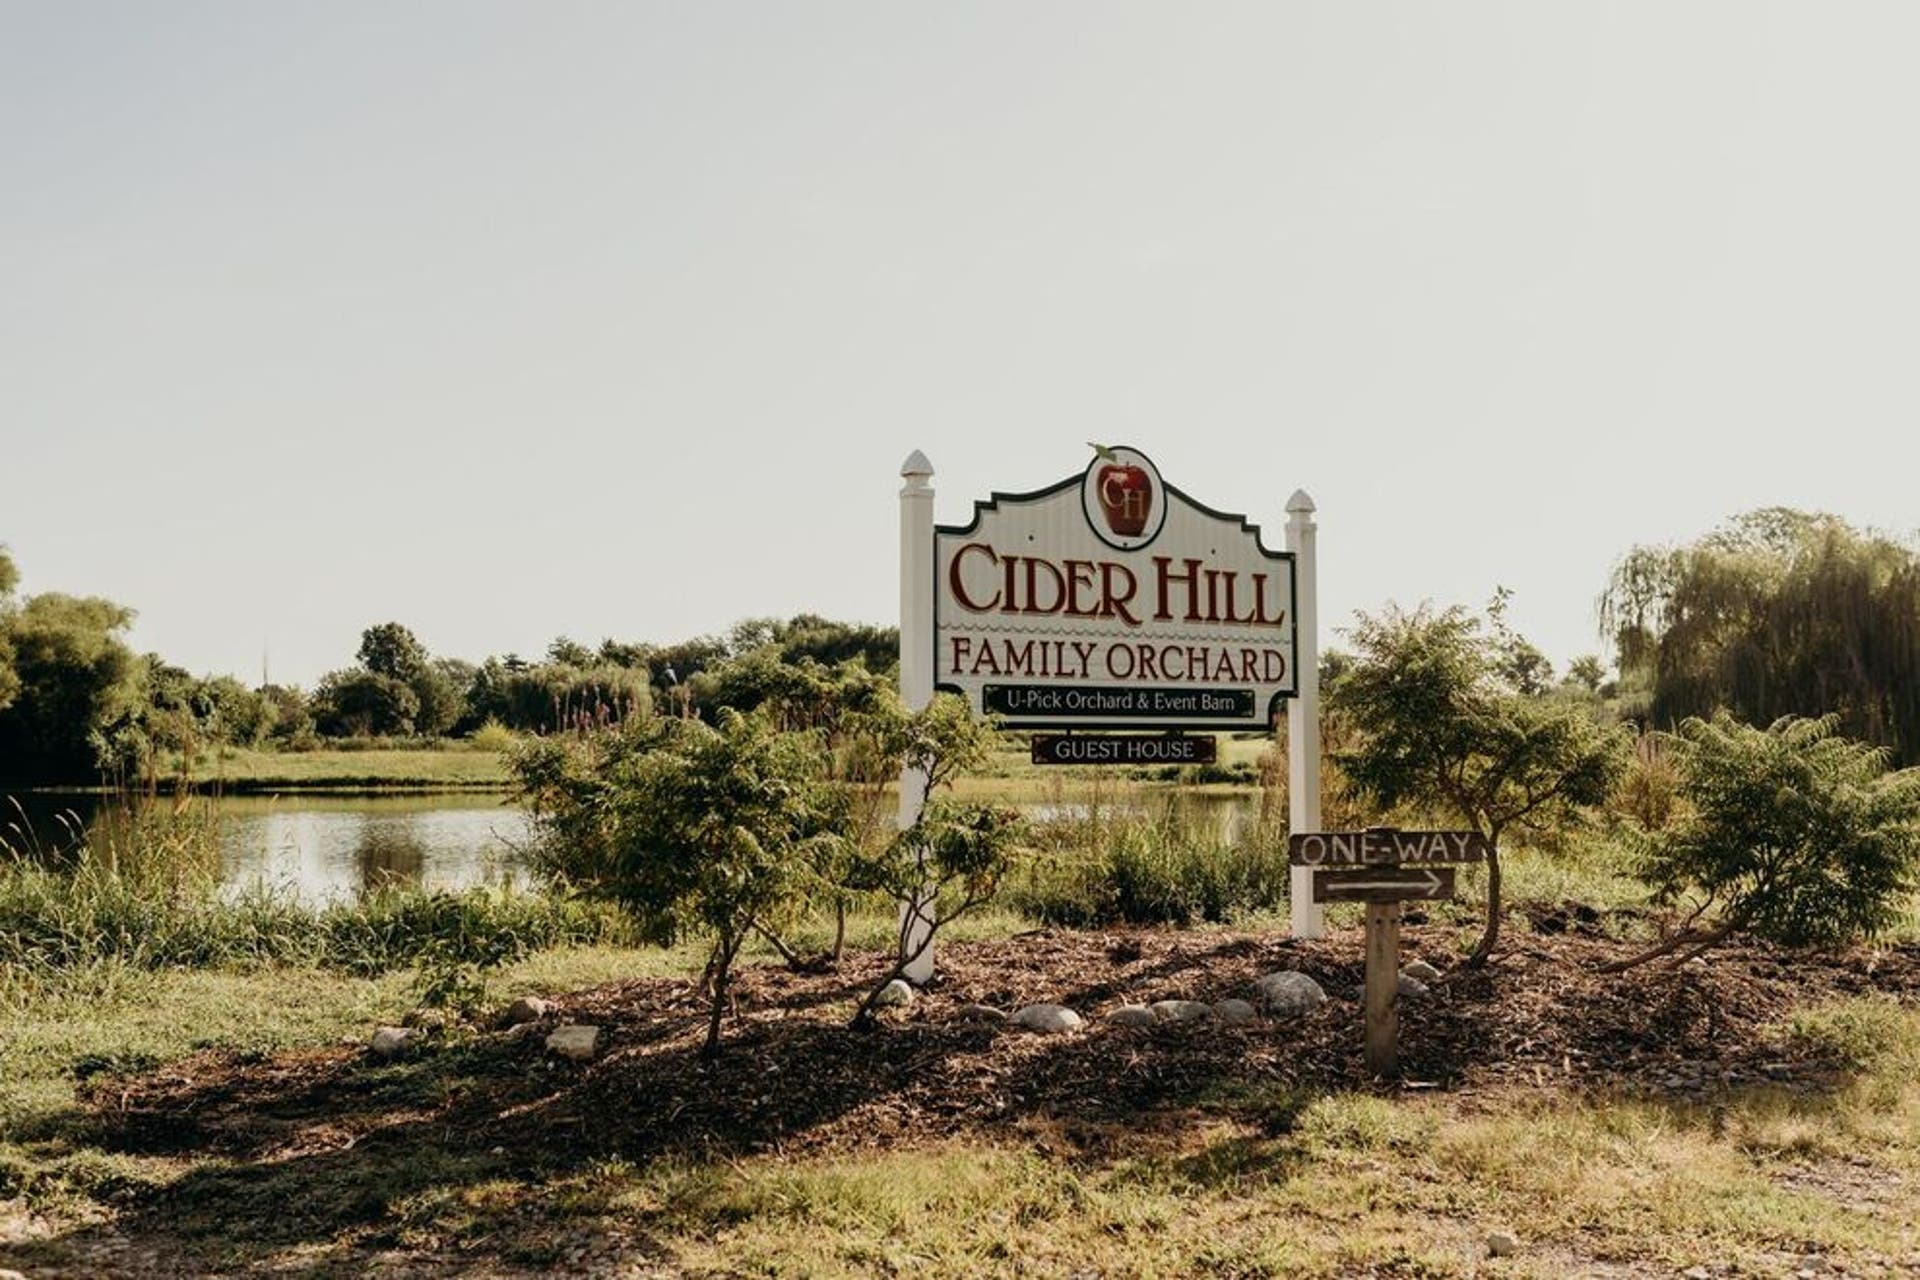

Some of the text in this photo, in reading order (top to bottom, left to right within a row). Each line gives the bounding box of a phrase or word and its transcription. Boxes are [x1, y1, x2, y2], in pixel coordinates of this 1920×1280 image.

[949, 543, 1286, 627] CIDER HILL
[951, 636, 1286, 683] FAMILY ORCHARD
[1007, 690, 1235, 711] U-Pick Orchard & Event Barn
[1055, 740, 1194, 759] GUEST HOUSE
[1300, 833, 1471, 864] ONE-WAY
